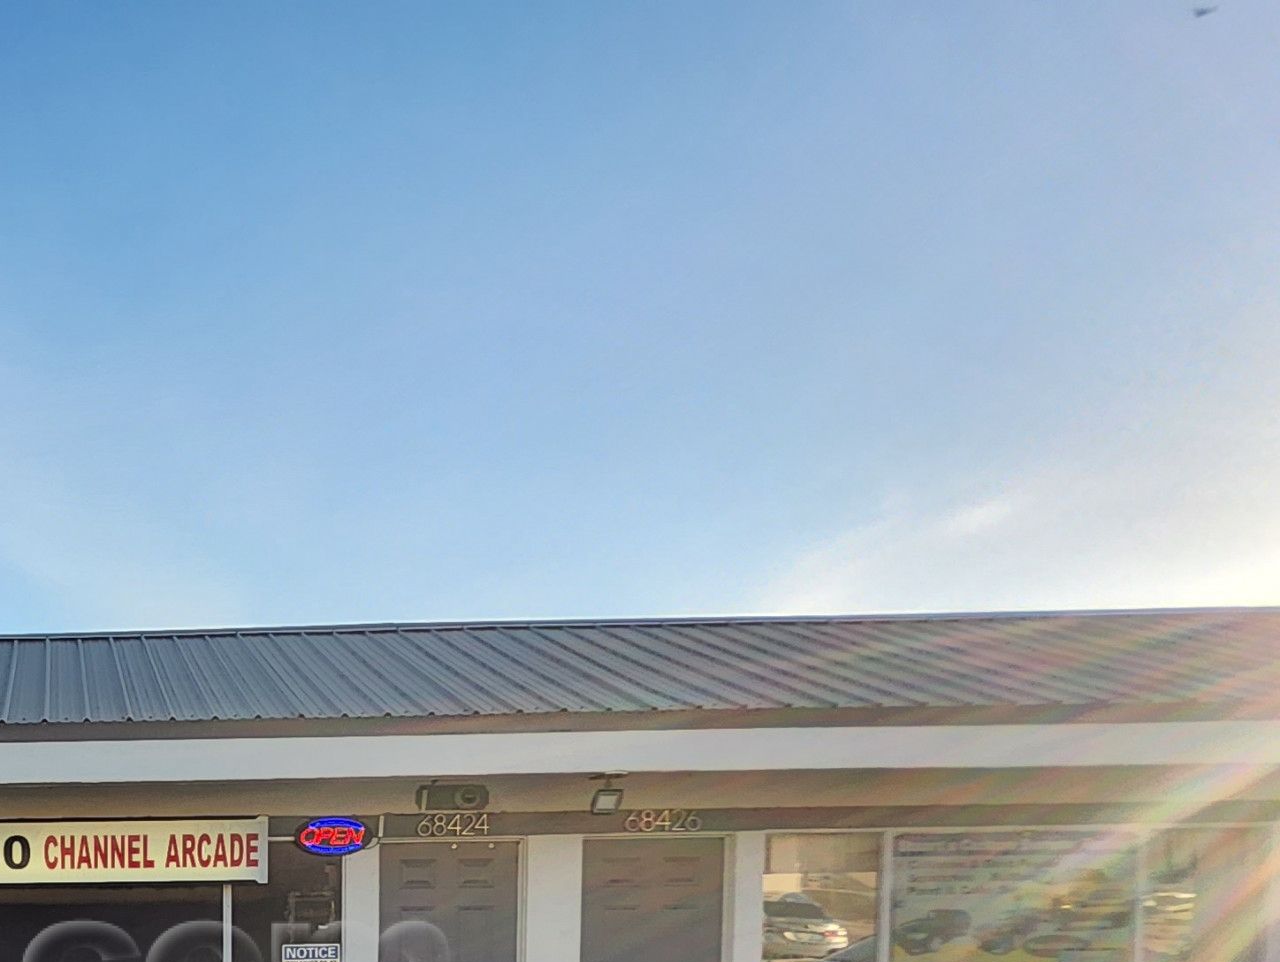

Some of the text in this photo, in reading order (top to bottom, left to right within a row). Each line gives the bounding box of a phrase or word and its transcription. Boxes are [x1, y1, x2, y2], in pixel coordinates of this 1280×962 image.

[417, 813, 489, 836] 68424
[625, 808, 702, 832] 68426
[300, 826, 366, 846] OPEN
[43, 834, 155, 869] CHANNEL
[165, 833, 259, 868] ARCADE
[286, 947, 336, 958] NOTICE
